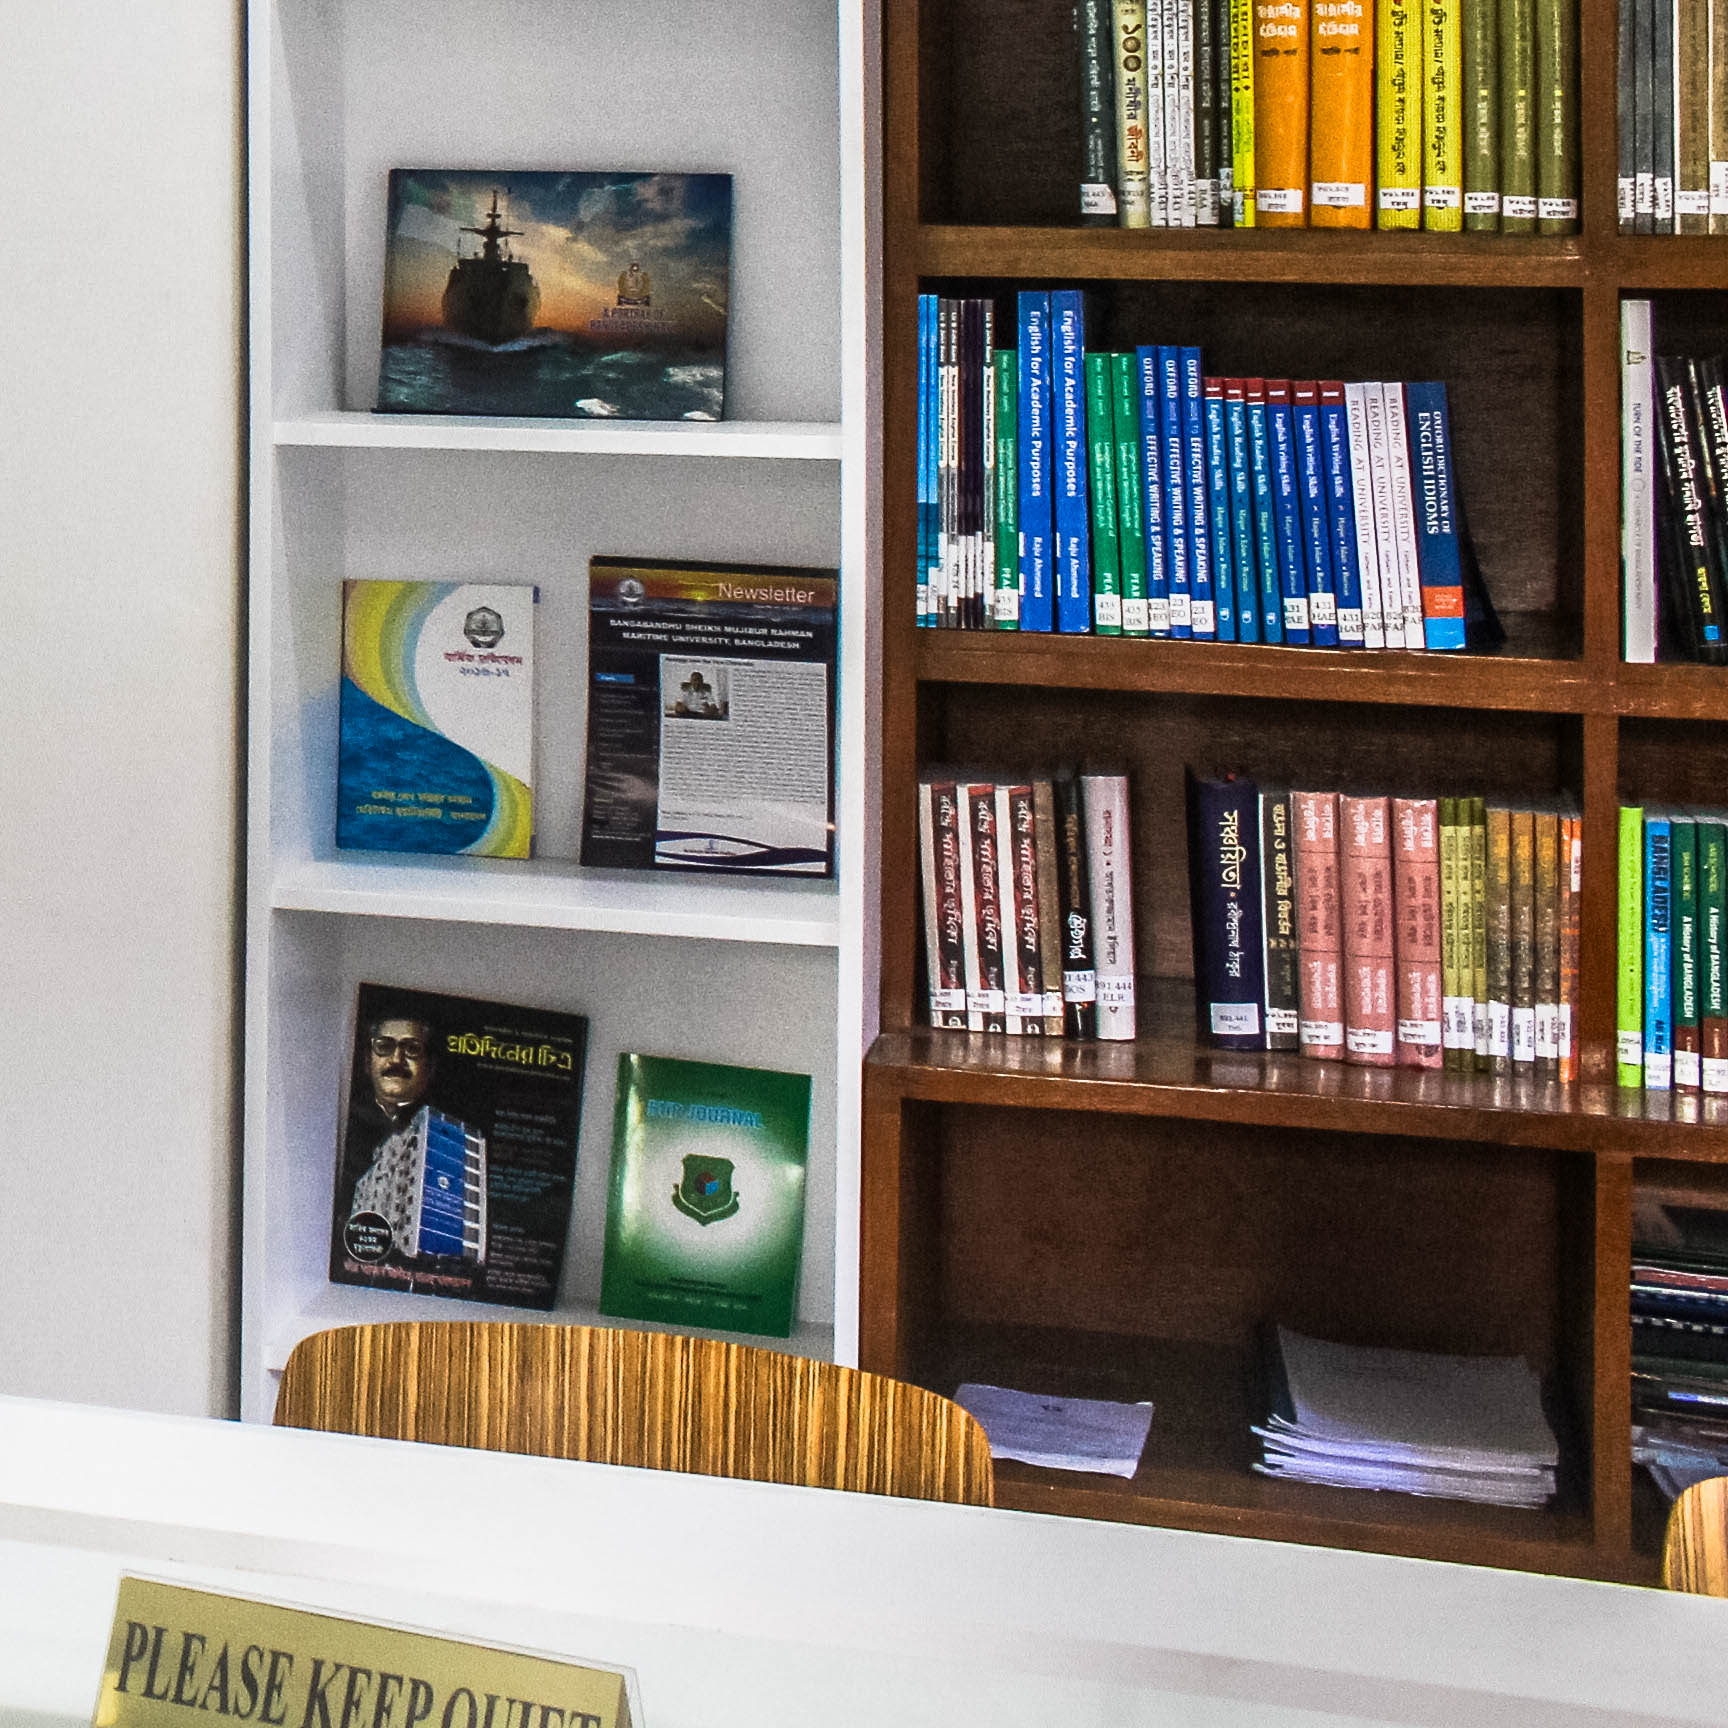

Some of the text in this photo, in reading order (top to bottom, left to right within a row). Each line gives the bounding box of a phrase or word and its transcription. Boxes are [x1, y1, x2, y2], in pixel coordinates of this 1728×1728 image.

[1122, 24, 1142, 72] ১০০
[1143, 357, 1156, 396] OXFORD
[1166, 359, 1178, 398] OXFORD
[1028, 311, 1043, 497] English for Academic Purposes
[1061, 311, 1079, 497] English for Academic Purposes
[1633, 426, 1642, 438] OF
[1146, 434, 1159, 482] EFFECTIVE
[1168, 437, 1182, 485] EFFECTIVE
[1369, 398, 1391, 543] READING AT UNIVERSITY
[1417, 412, 1439, 535] ENGLISH IDIOMS
[1432, 411, 1451, 535] OXFORD DICTIONARY OF
[1148, 484, 1161, 523] WRITING
[1171, 487, 1183, 526] WRITING
[1151, 534, 1164, 580] SPEAKING
[1173, 537, 1185, 583] SPEAKING
[718, 583, 816, 603] Newsletter
[734, 639, 800, 649] BANGLADESH
[688, 1104, 765, 1128] JOURNAL
[114, 1618, 295, 1726] PLEASE
[299, 1654, 435, 1728] KEEP
